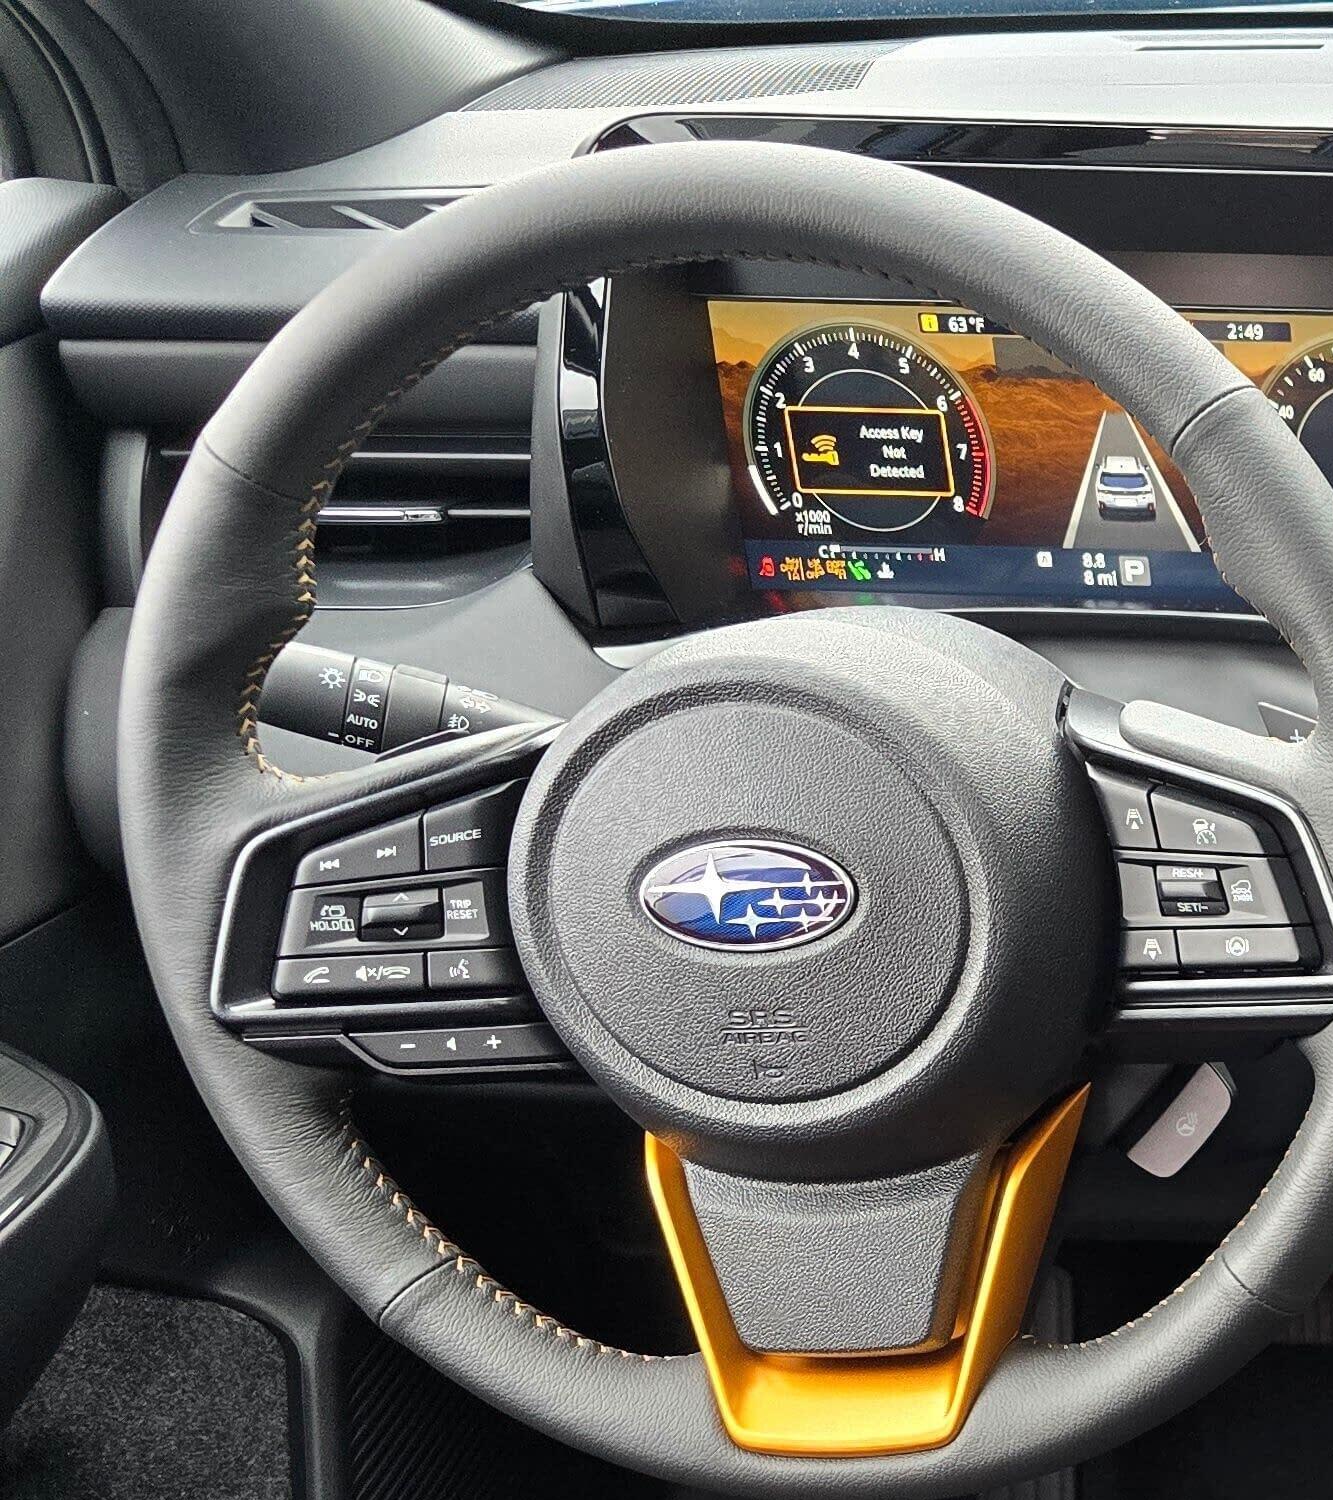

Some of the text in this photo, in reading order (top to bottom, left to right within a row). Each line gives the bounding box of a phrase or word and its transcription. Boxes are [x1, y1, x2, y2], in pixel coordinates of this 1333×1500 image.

[948, 316, 985, 333] 63°F
[1227, 323, 1264, 341] 2:49
[847, 344, 860, 359] 4
[804, 357, 814, 373] 3
[899, 358, 910, 374] 5
[1309, 369, 1325, 384] 60
[774, 393, 786, 409] 2
[937, 396, 948, 412] 6
[1280, 405, 1294, 420] 40
[859, 425, 924, 443] Access Key
[774, 443, 783, 458] 1
[883, 445, 907, 459] Not
[957, 444, 968, 460] 7
[870, 464, 925, 479] Detected
[792, 492, 803, 507] 0
[953, 496, 964, 511] 8
[934, 547, 946, 561] H
[1124, 559, 1146, 582] P
[1083, 571, 1094, 586] 8
[346, 713, 378, 731] AUTO
[345, 734, 375, 749] OFF
[429, 829, 482, 848] SOURCE
[449, 899, 472, 910] TRIP
[446, 908, 479, 921] RESET
[310, 920, 340, 932] HOLD
